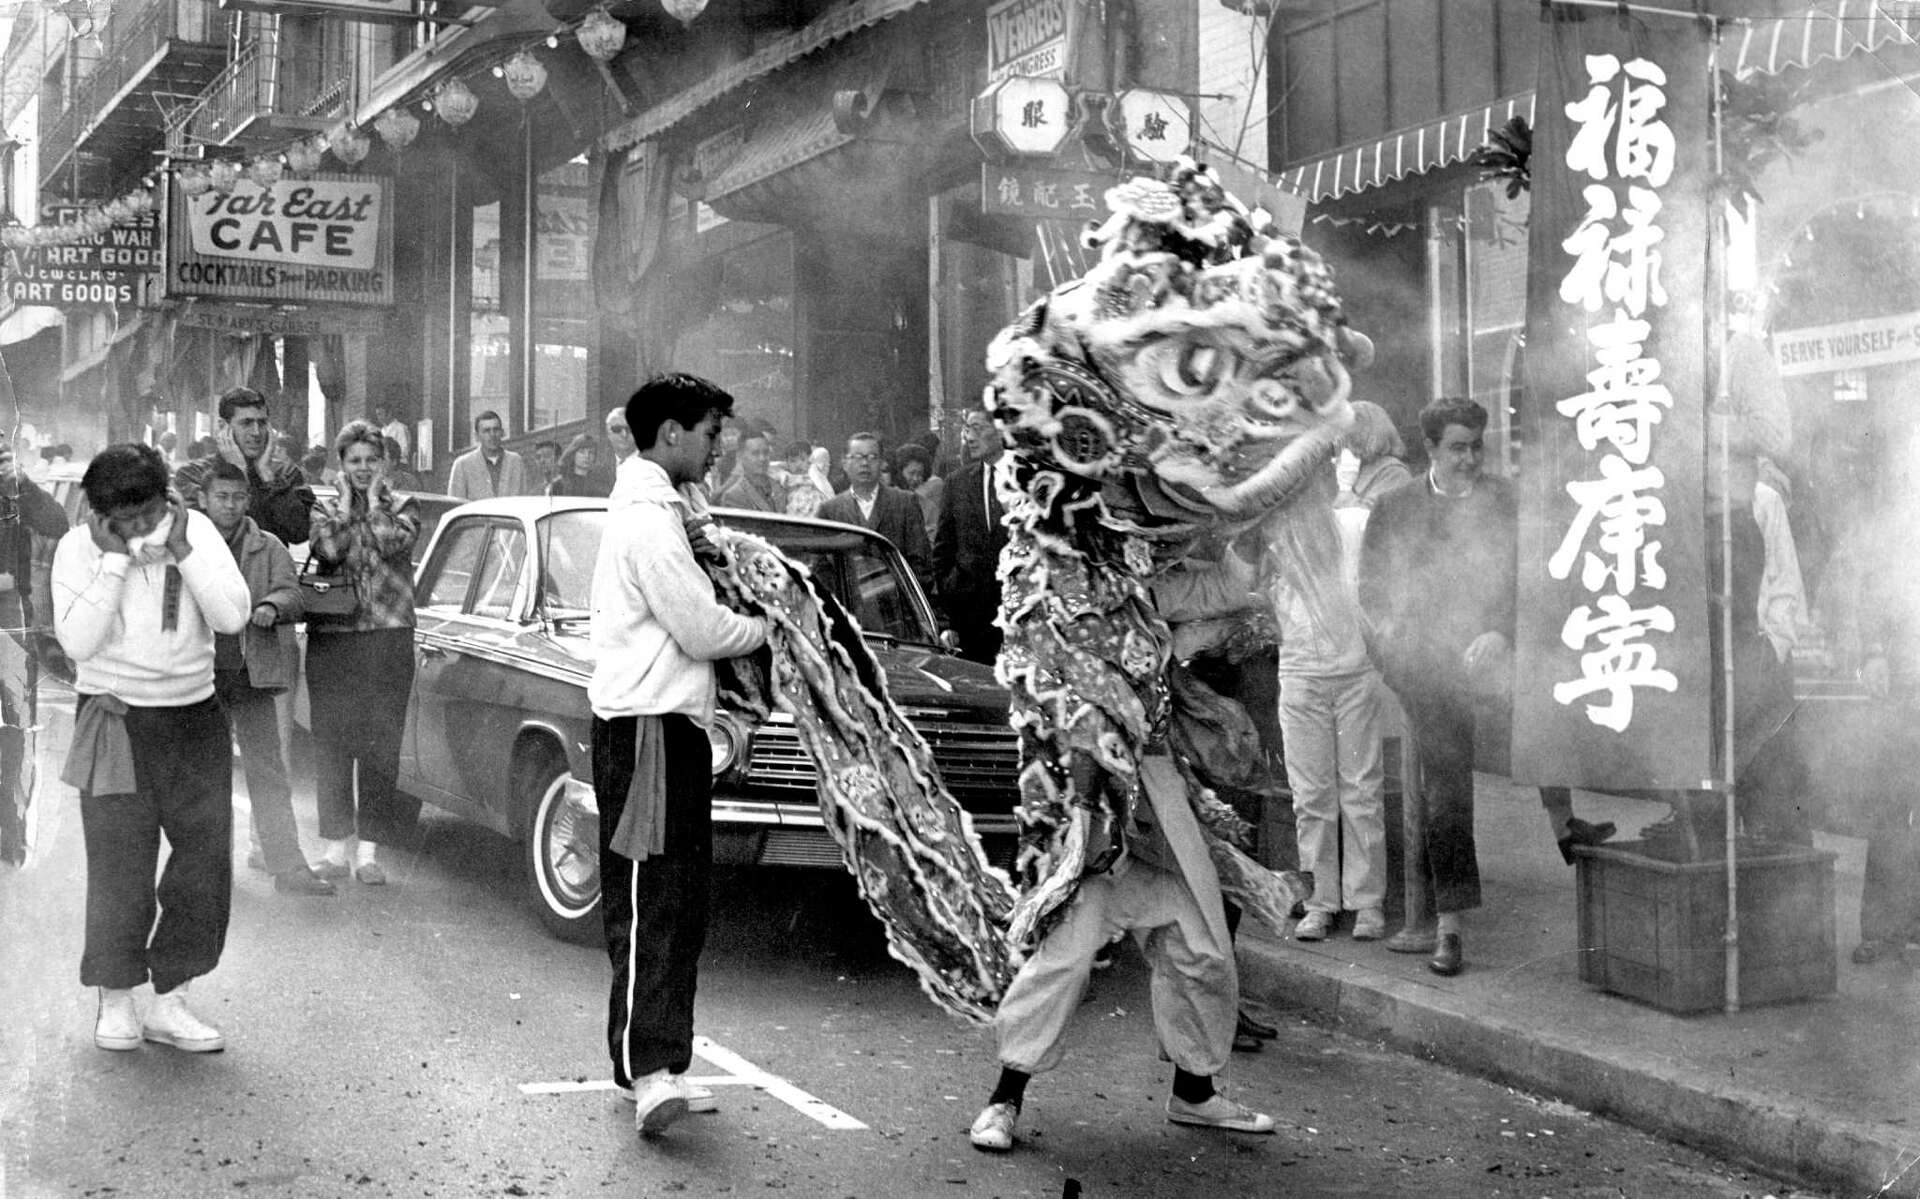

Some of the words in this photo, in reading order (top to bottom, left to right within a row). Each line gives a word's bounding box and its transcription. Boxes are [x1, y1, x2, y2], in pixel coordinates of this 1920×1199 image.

[282, 187, 372, 221] East
[113, 230, 152, 246] WAH
[210, 217, 354, 256] CAFE
[47, 248, 93, 265] ART
[14, 282, 54, 300] ART
[62, 283, 131, 302] GOODS
[178, 262, 276, 287] COCKTAILS
[305, 268, 383, 293] PARKING
[1780, 339, 1824, 366] SERVE
[1827, 329, 1895, 358] YOURSELF
